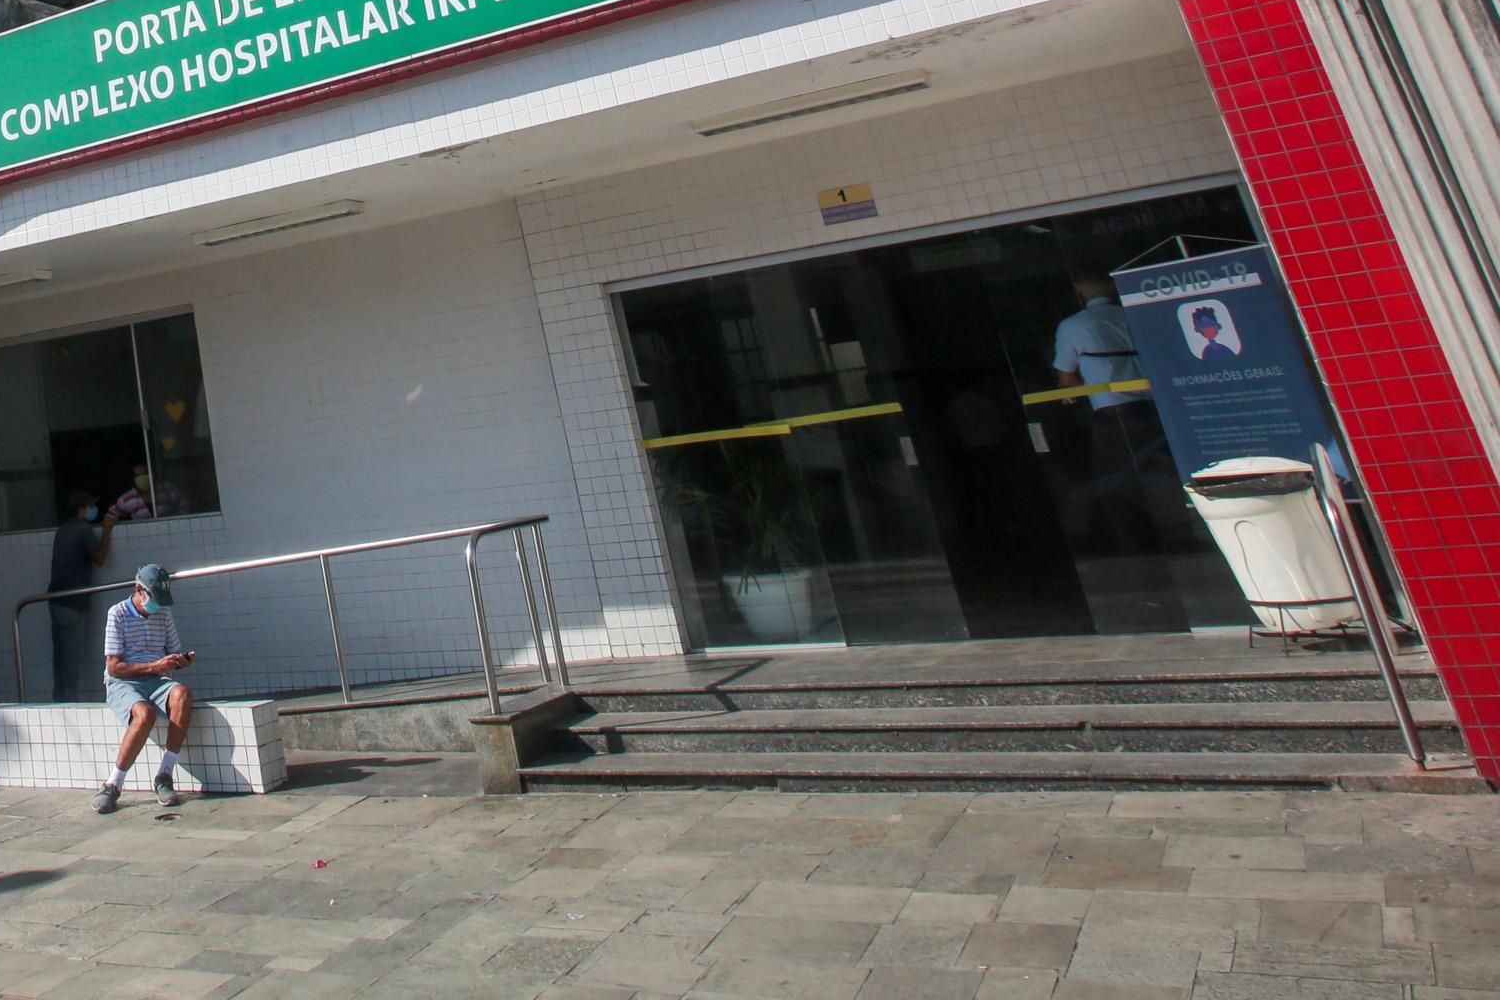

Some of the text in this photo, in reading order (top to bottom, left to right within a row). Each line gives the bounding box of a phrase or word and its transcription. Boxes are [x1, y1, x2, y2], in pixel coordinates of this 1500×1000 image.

[93, 0, 208, 64] PORTA
[0, 63, 175, 141] COMPLEXO
[837, 189, 847, 202] 1
[1139, 261, 1248, 299] COVID-19
[1172, 365, 1285, 387] INFORMAÇÕES GERAIS:
